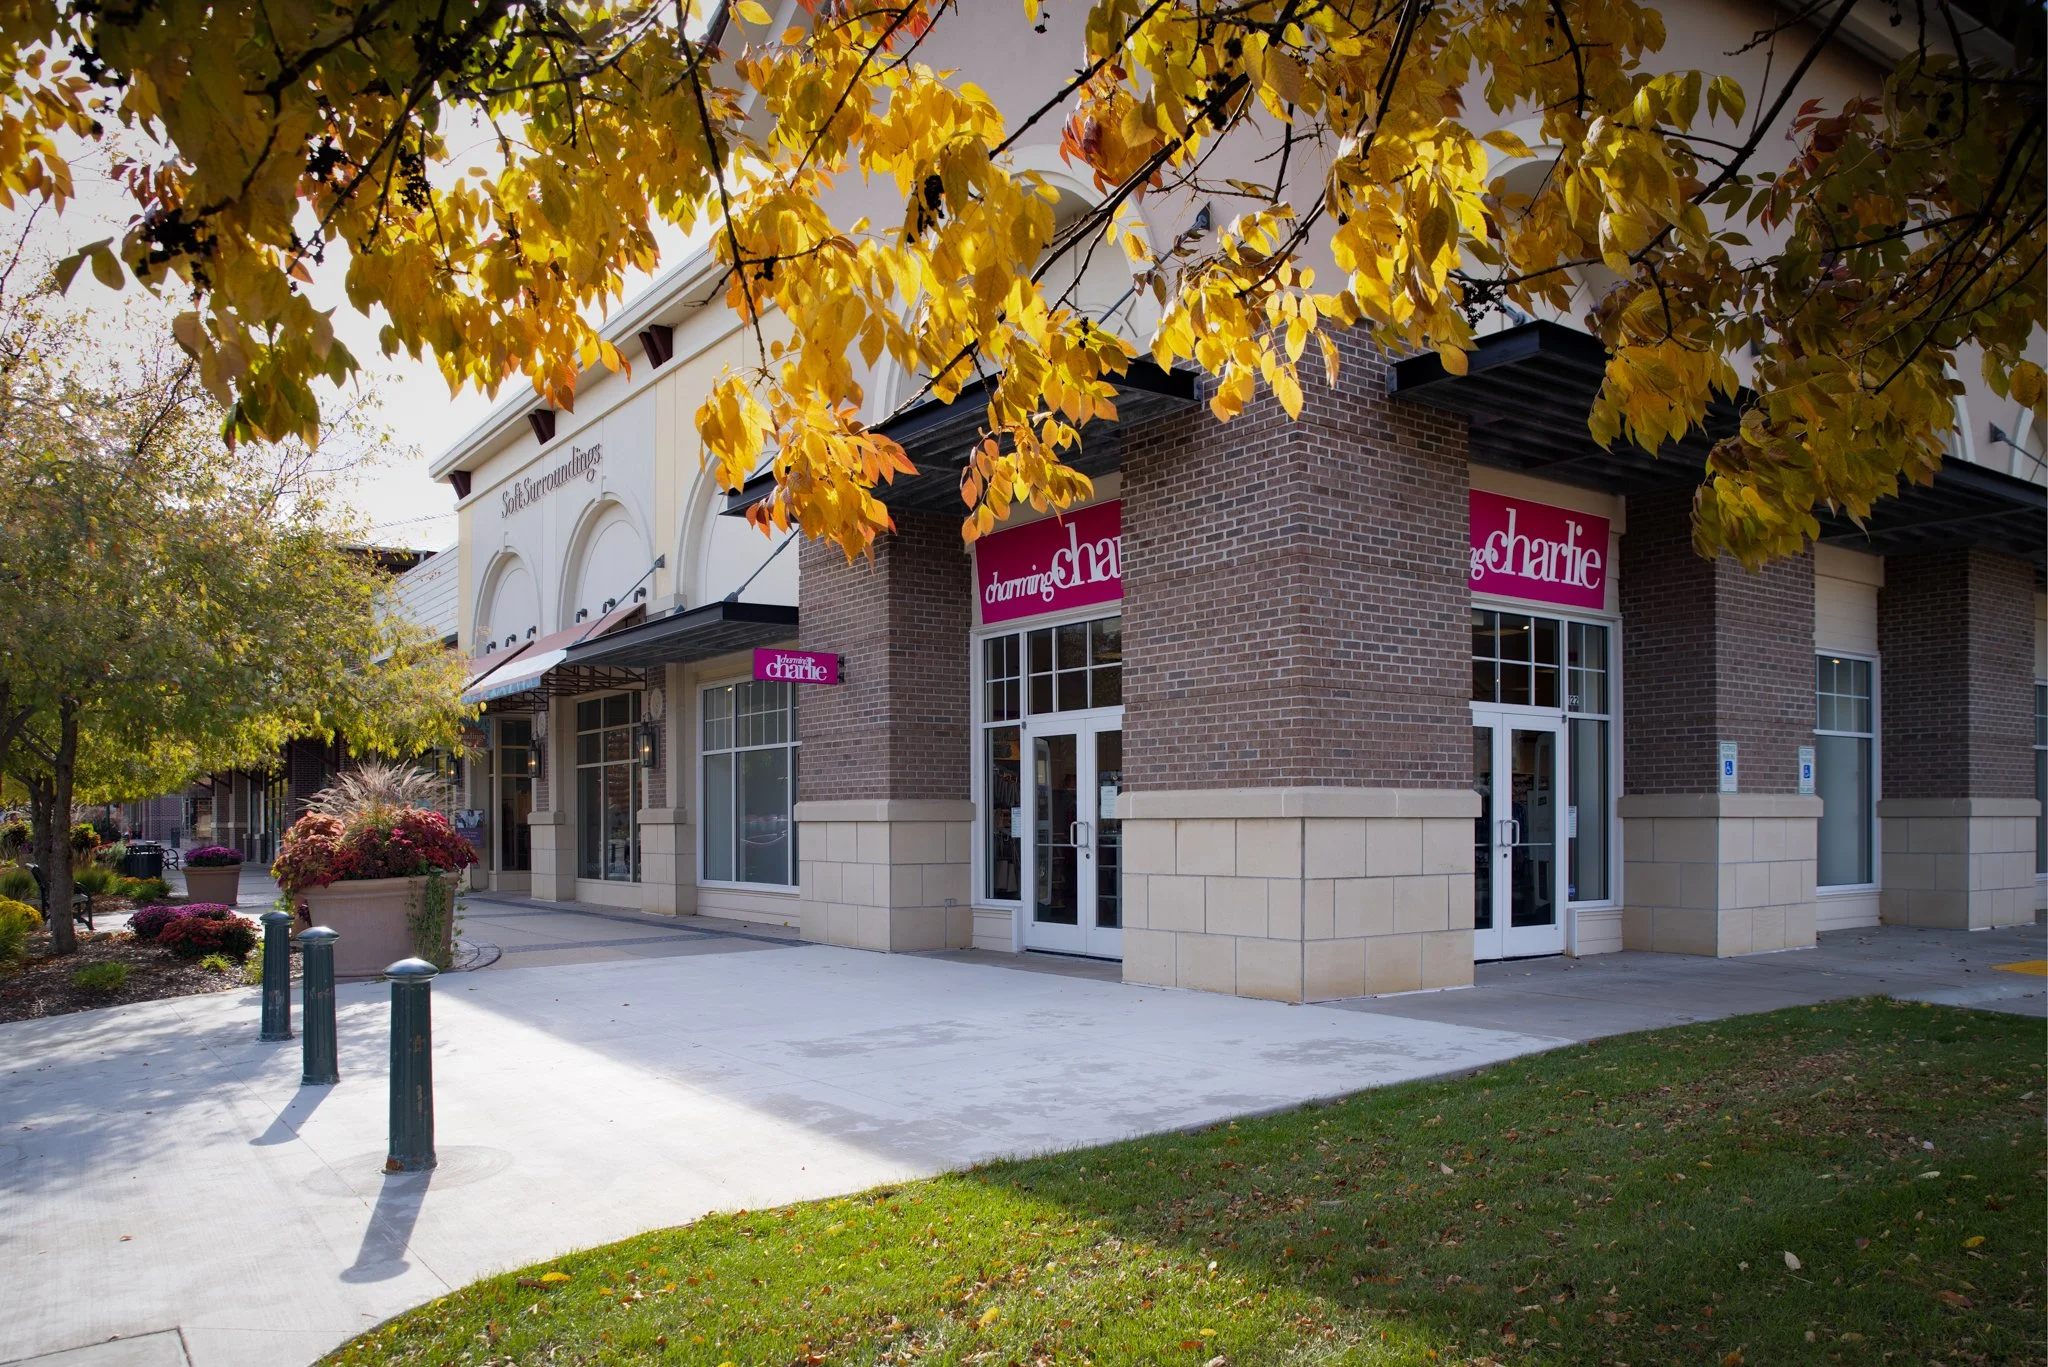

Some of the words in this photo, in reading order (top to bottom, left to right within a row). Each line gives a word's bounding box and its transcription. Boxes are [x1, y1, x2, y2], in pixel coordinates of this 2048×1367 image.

[501, 482, 523, 518] Soft
[523, 443, 602, 506] Surroundings
[1485, 508, 1602, 589] charlie
[985, 564, 1062, 603] charming
[766, 655, 828, 681] charlie
